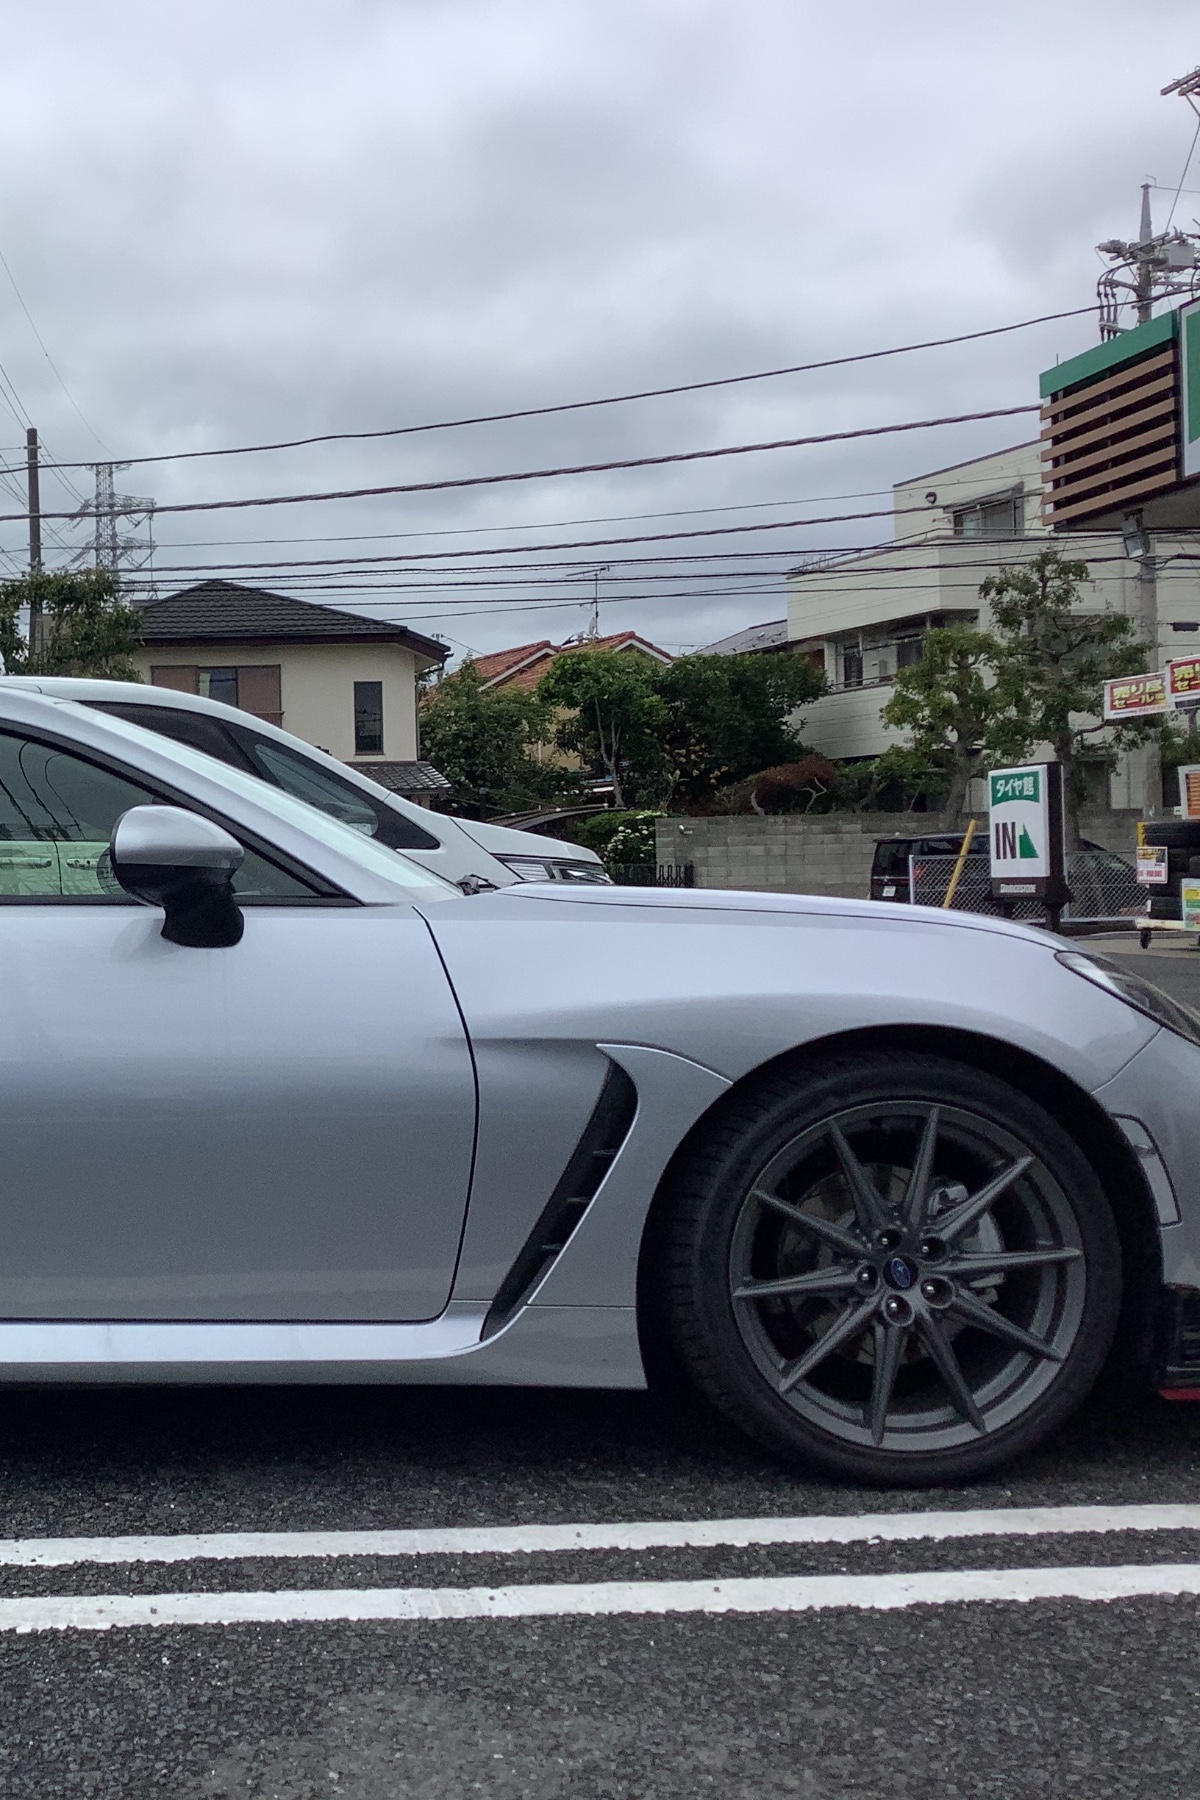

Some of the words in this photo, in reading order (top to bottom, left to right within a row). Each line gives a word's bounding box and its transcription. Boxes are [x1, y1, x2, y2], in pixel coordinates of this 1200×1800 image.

[1112, 679, 1166, 699] 売り尽
[996, 776, 1035, 797] タイヤ館
[995, 821, 1017, 860] IN
